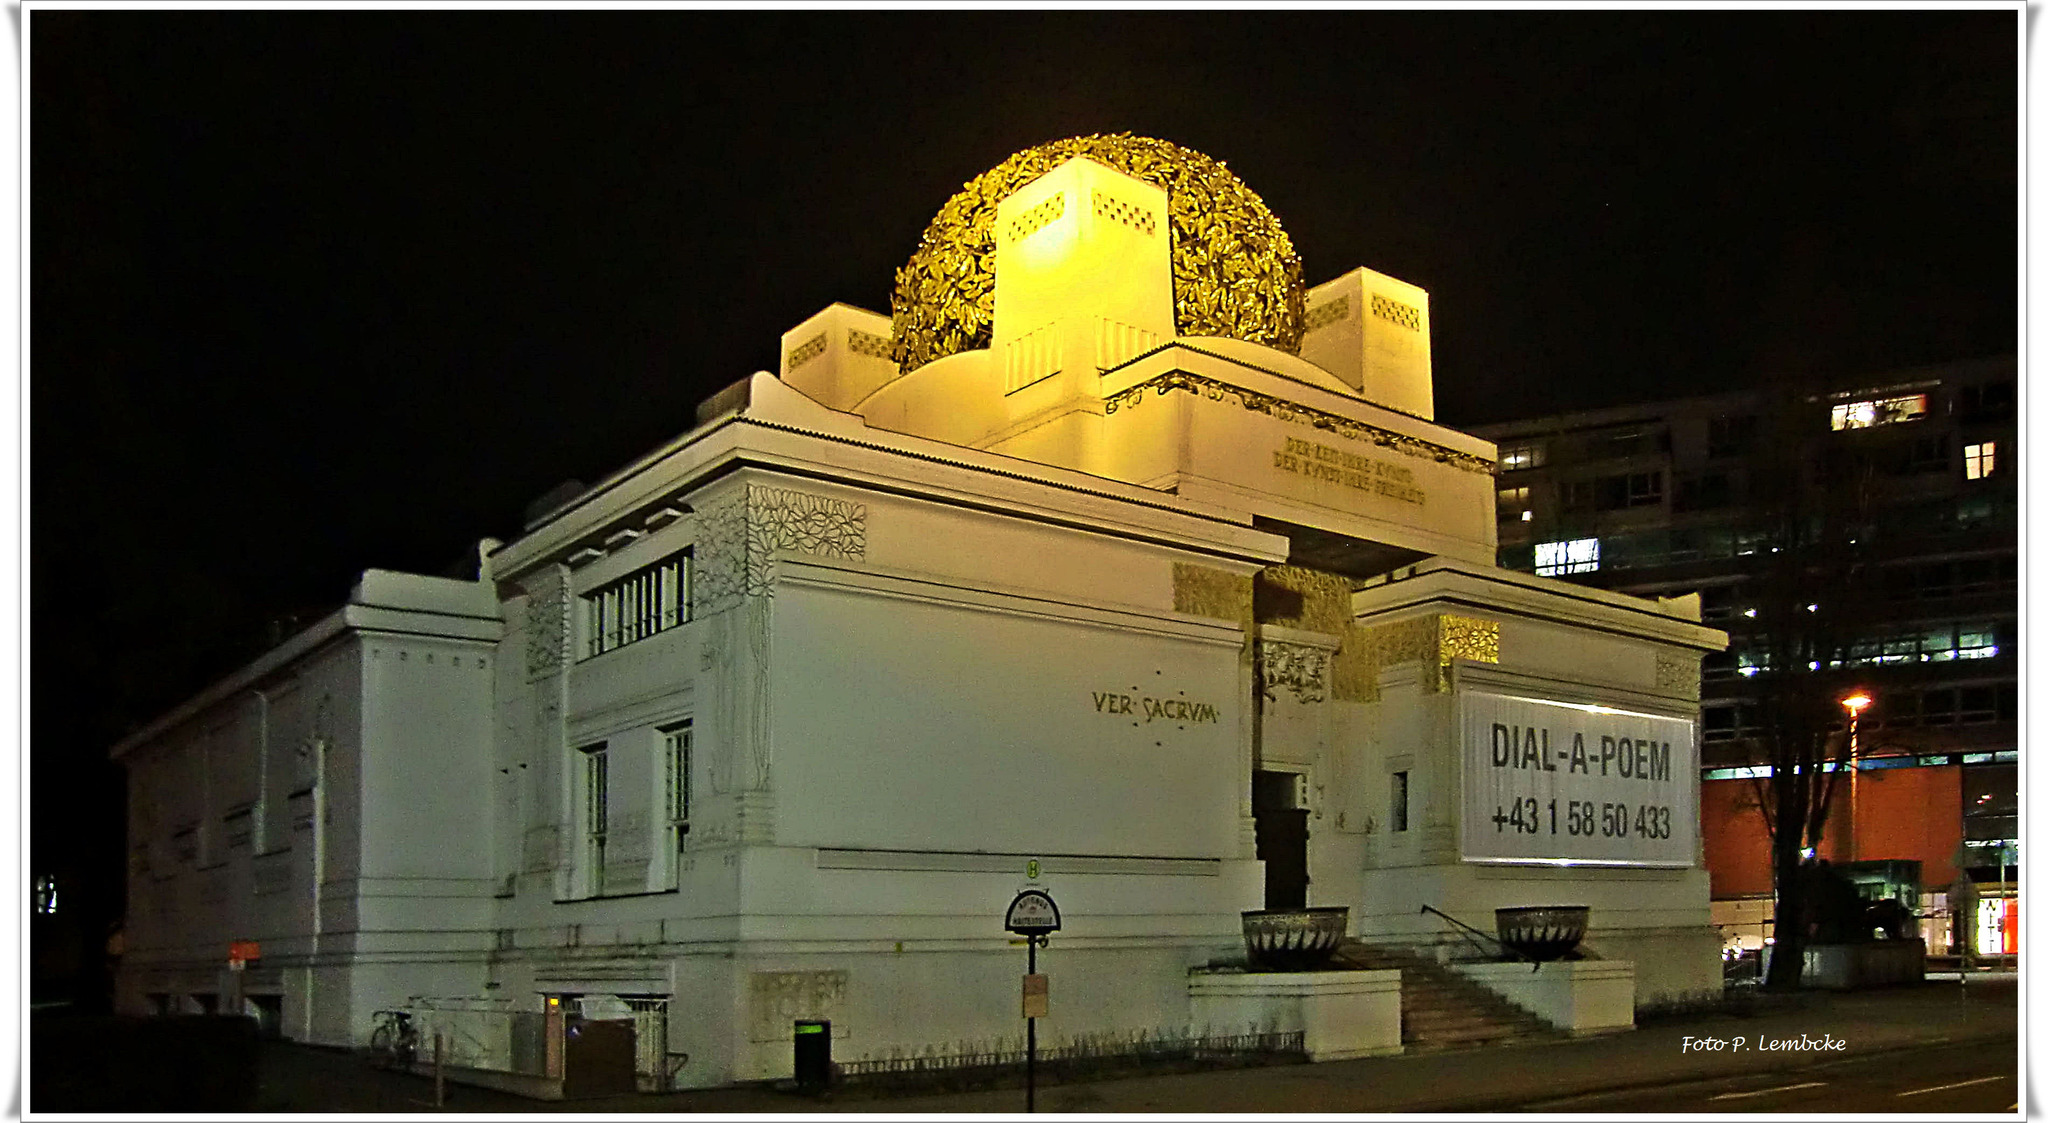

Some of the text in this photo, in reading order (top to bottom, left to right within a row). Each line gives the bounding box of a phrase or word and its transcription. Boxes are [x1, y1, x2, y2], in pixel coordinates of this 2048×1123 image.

[1492, 722, 1671, 783] DIAL-A-POEM
[1491, 796, 1671, 840] +43 1 58 50 433
